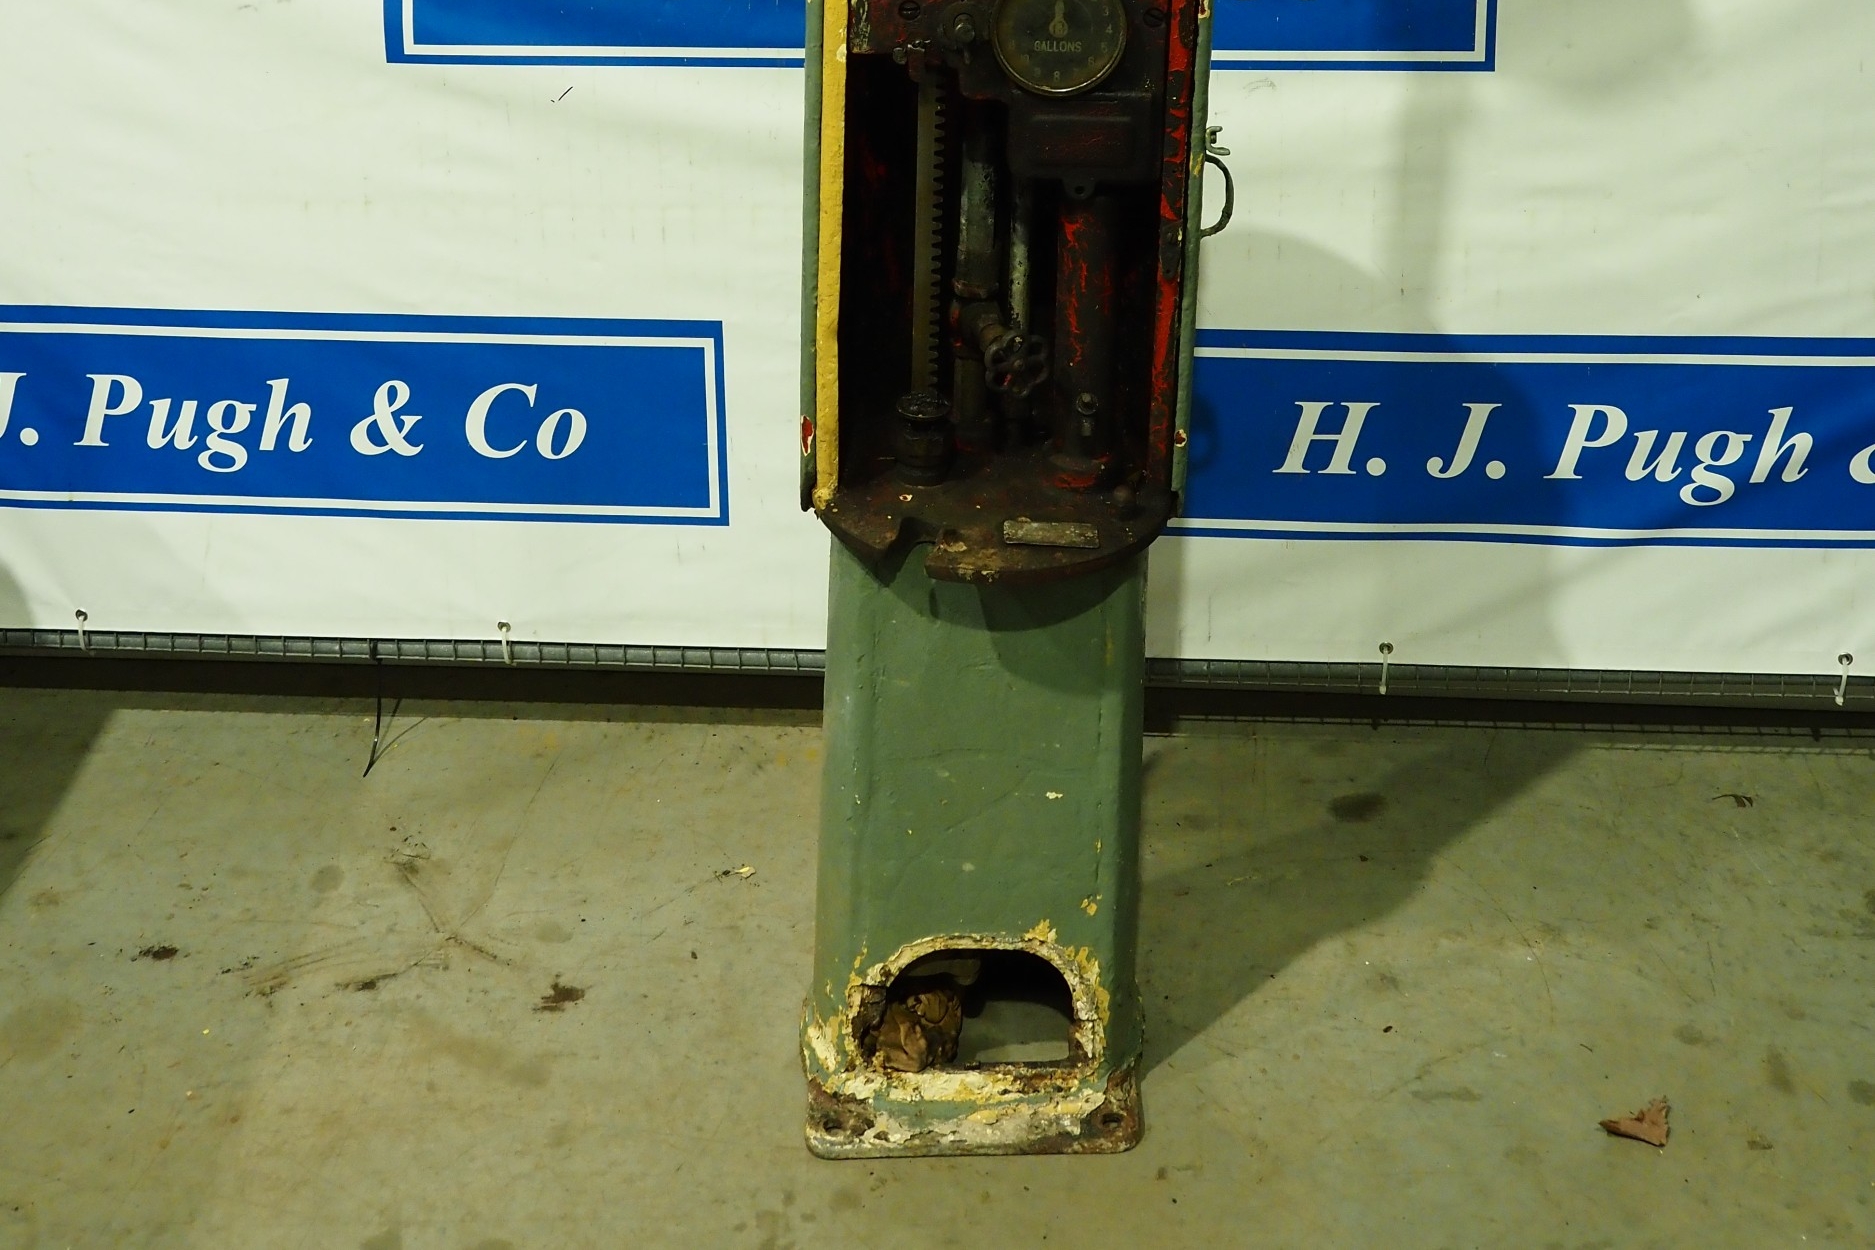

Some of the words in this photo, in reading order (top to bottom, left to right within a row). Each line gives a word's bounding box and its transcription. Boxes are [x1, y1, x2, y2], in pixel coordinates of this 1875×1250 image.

[1033, 40, 1083, 53] GALLONS
[73, 373, 314, 473] Pugh
[350, 379, 424, 457] &
[465, 382, 587, 460] Co
[1272, 401, 1387, 477] H.
[1426, 403, 1506, 480] J.
[1543, 403, 1814, 506] Pugh
